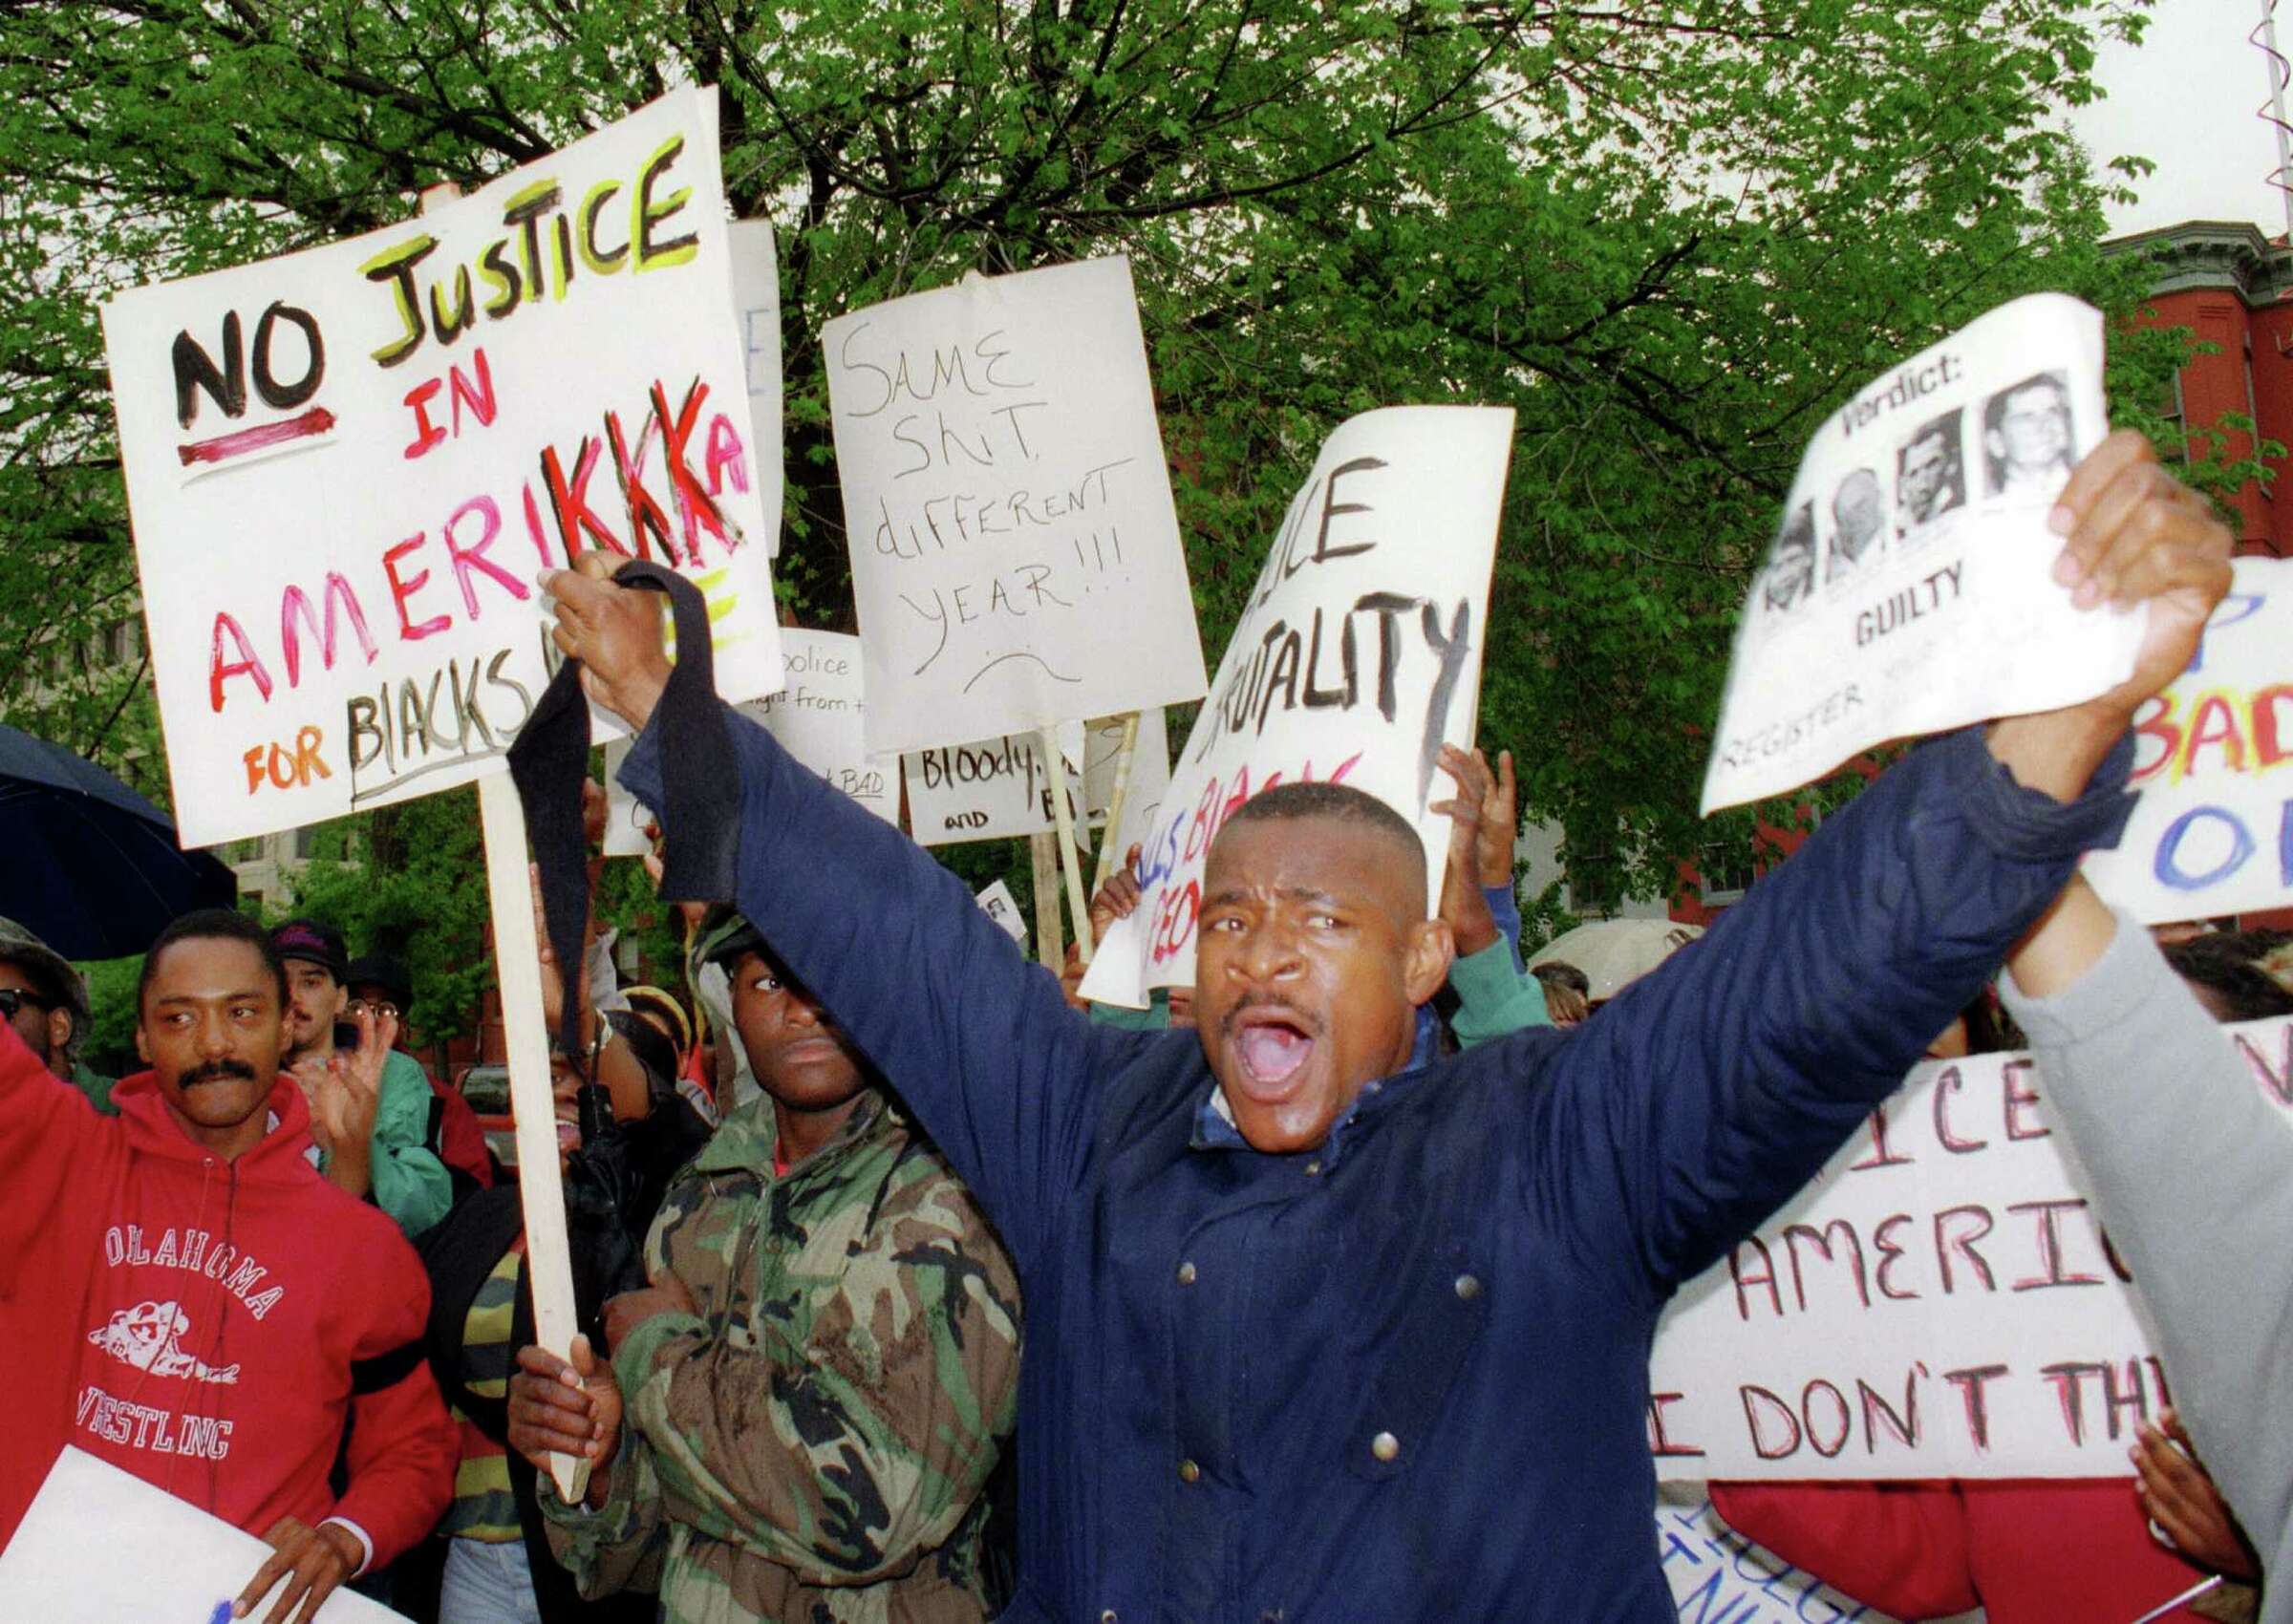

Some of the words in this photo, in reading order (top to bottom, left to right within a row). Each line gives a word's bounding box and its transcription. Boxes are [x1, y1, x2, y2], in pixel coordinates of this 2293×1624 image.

[170, 299, 327, 430] NO
[403, 346, 496, 459] IN
[842, 322, 1036, 417] SAME
[1838, 353, 1963, 438] Verdict:
[210, 374, 749, 713] AMERIKKKA
[1854, 559, 1964, 648] GUILTY
[794, 685, 848, 712] from
[243, 724, 334, 796] FOR
[104, 1224, 285, 1321] OLAHOMA
[1726, 1198, 2132, 1322] AMERI
[1647, 1393, 1706, 1458] I
[1738, 1360, 2009, 1461] DON'T
